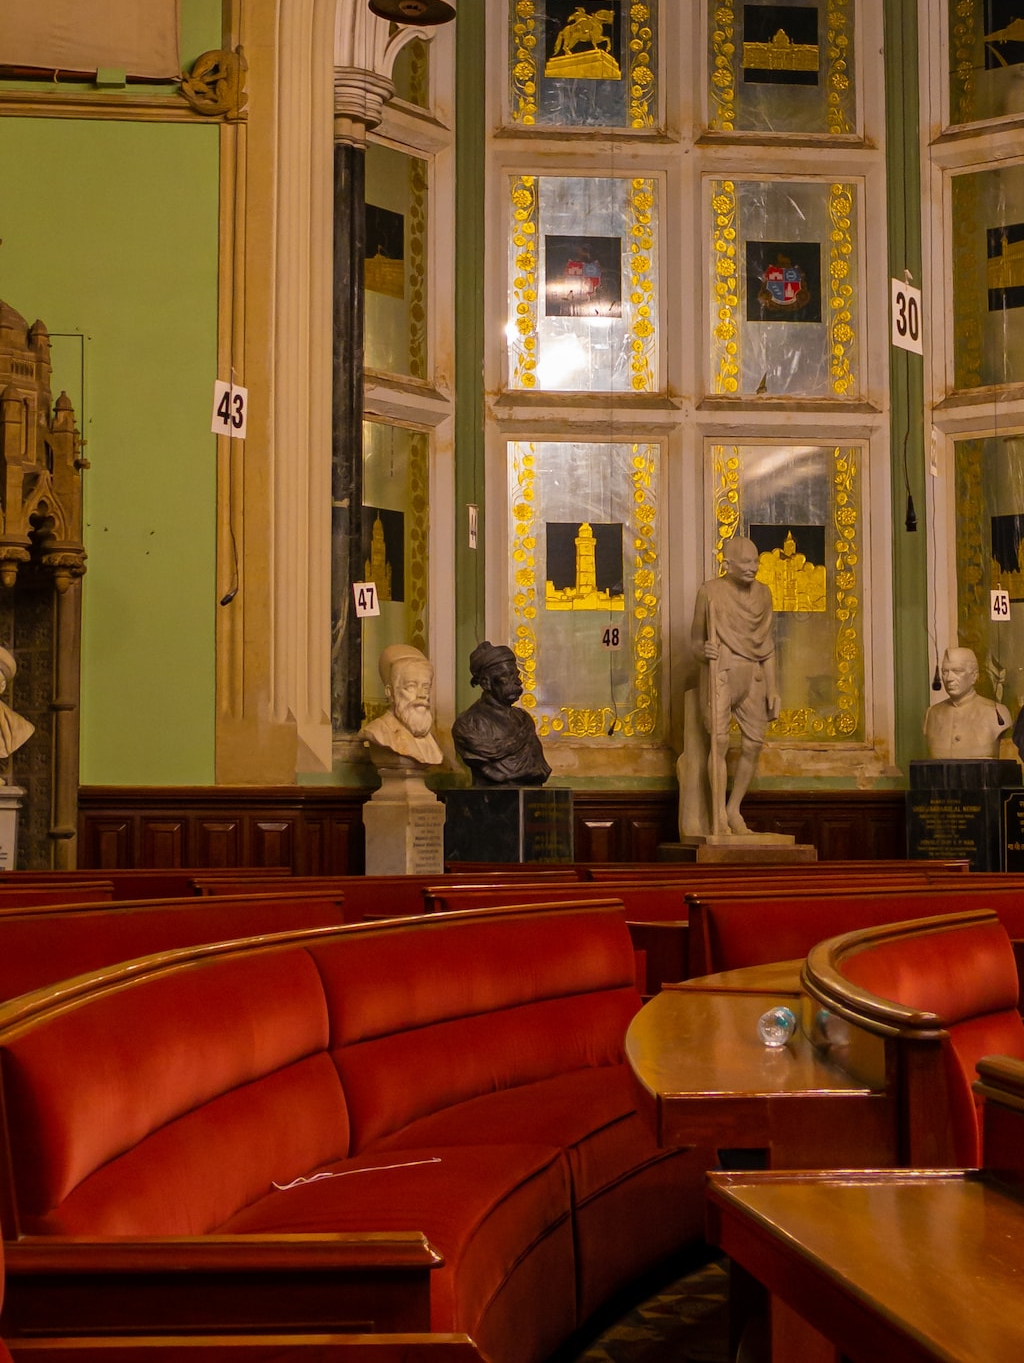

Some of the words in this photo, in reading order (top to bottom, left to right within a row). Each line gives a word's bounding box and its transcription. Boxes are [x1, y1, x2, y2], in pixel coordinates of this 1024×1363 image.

[896, 291, 919, 342] 30
[217, 391, 244, 429] 43
[358, 587, 374, 610] 47
[993, 595, 1008, 615] 45
[602, 627, 620, 647] 48
